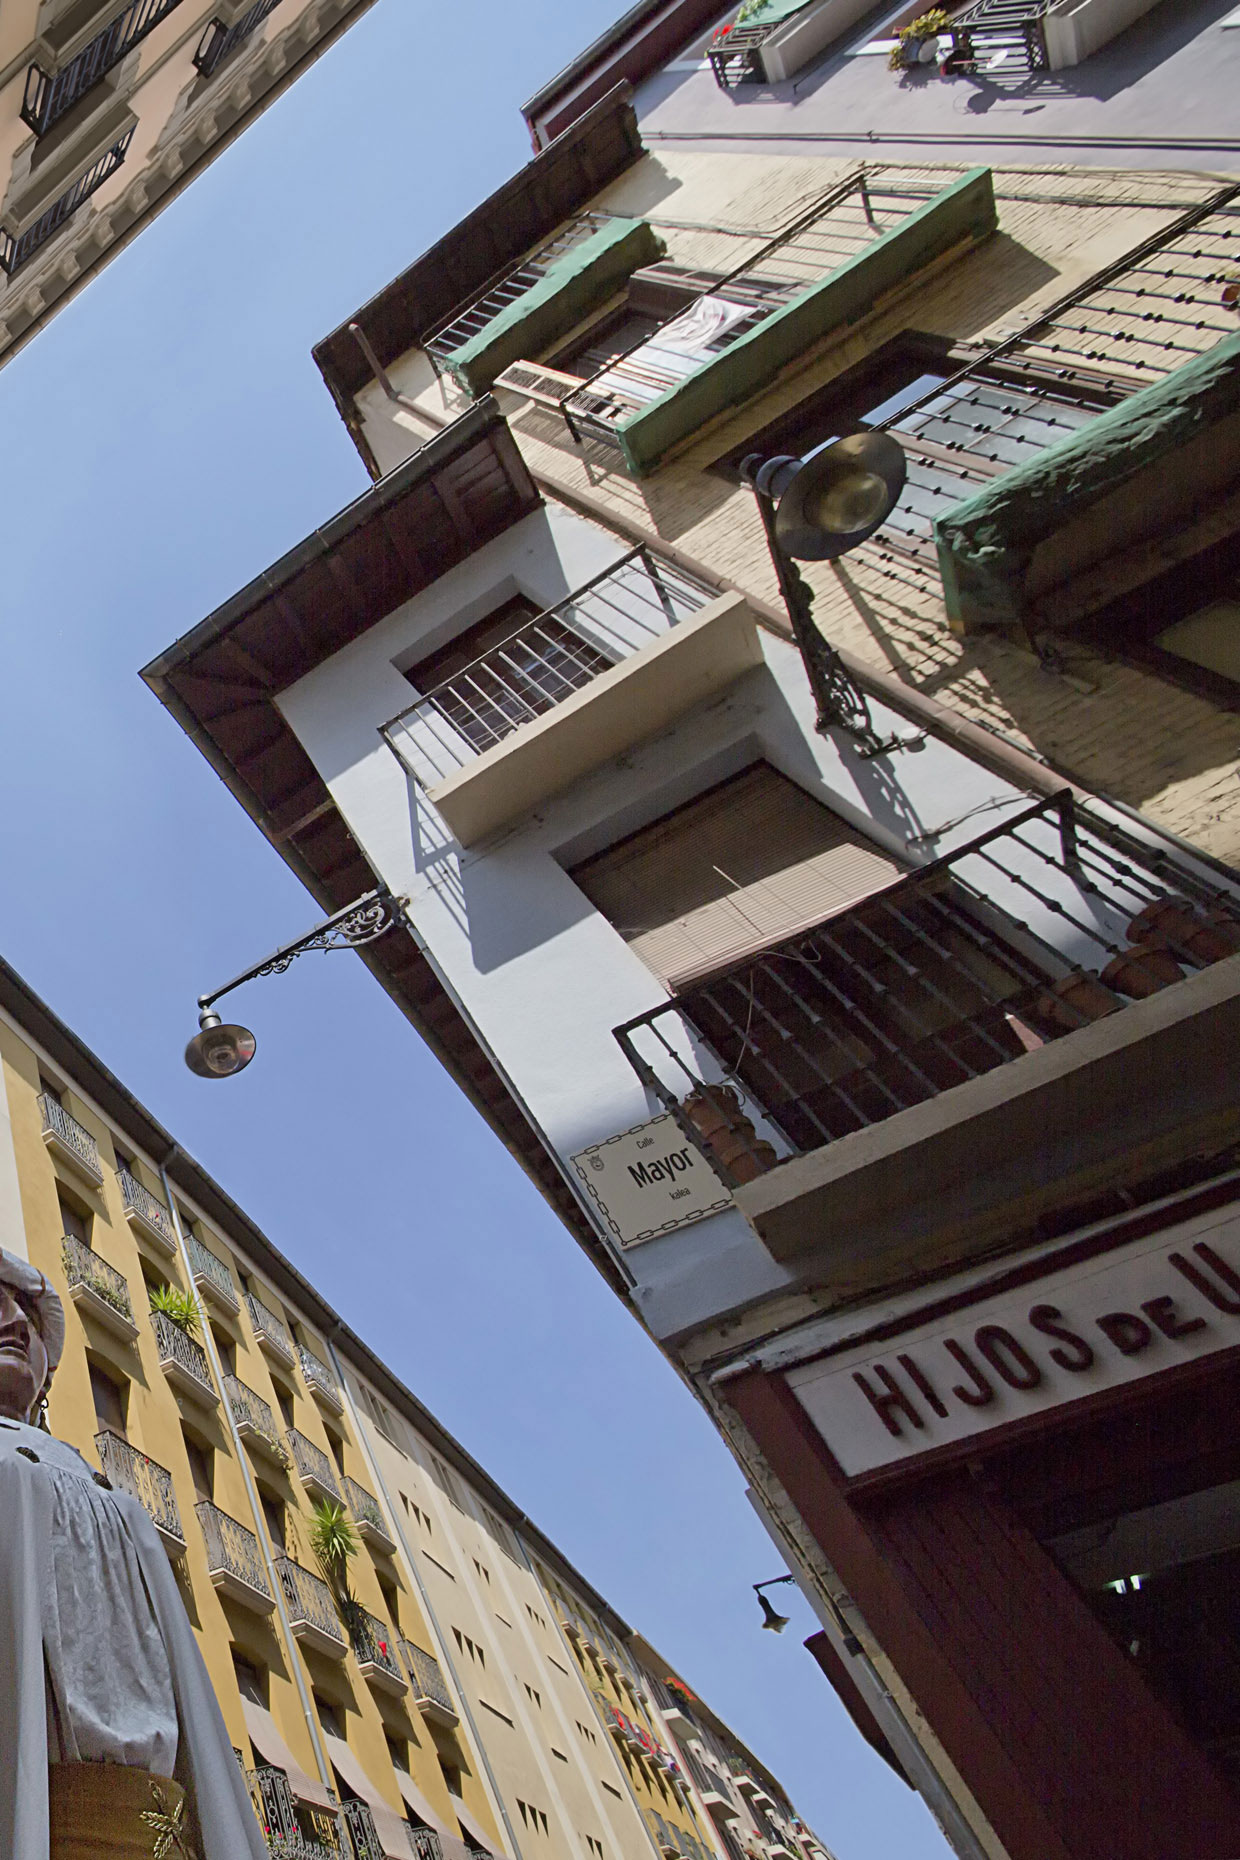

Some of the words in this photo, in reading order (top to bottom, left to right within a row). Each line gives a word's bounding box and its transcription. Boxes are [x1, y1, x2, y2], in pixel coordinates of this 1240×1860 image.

[636, 1136, 655, 1150] Calle
[627, 1147, 694, 1188] Mayor
[669, 1186, 691, 1201] kalea
[851, 1303, 1094, 1437] HIJOS
[1095, 1295, 1208, 1357] DE
